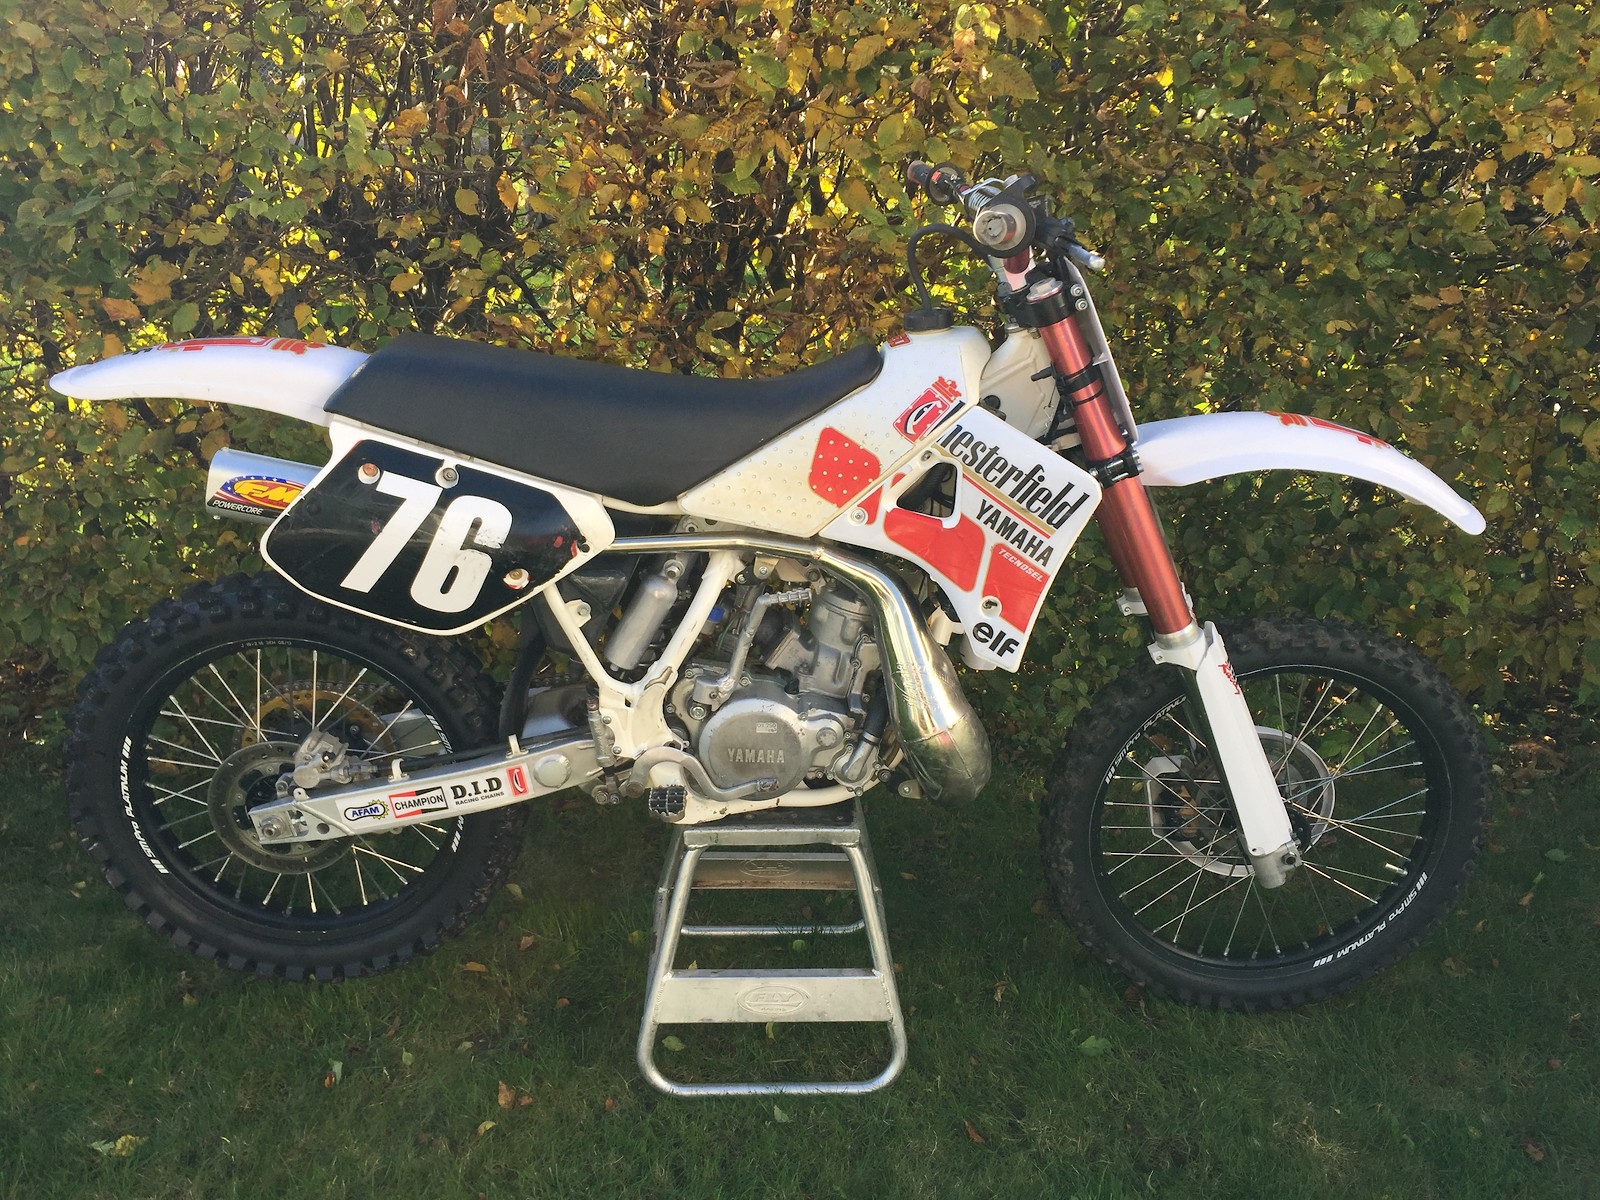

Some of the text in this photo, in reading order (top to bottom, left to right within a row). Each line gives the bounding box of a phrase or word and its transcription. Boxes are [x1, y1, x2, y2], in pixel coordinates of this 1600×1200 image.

[233, 482, 303, 503] FM
[212, 499, 264, 516] POWERCORE
[340, 471, 513, 613] 76
[975, 499, 1055, 568] YAMAHA
[998, 548, 1043, 583] TECNOSEL
[972, 622, 1020, 657] elf
[1143, 696, 1187, 731] PLATINU
[727, 747, 785, 763] YAMAHA
[119, 759, 135, 818] PLATINUM
[450, 777, 503, 799] D.I.D
[455, 791, 505, 806] RACING CHAINS
[351, 804, 380, 819] AFAM
[394, 793, 445, 812] CHAMPION
[1336, 920, 1387, 958] PLATINUM
